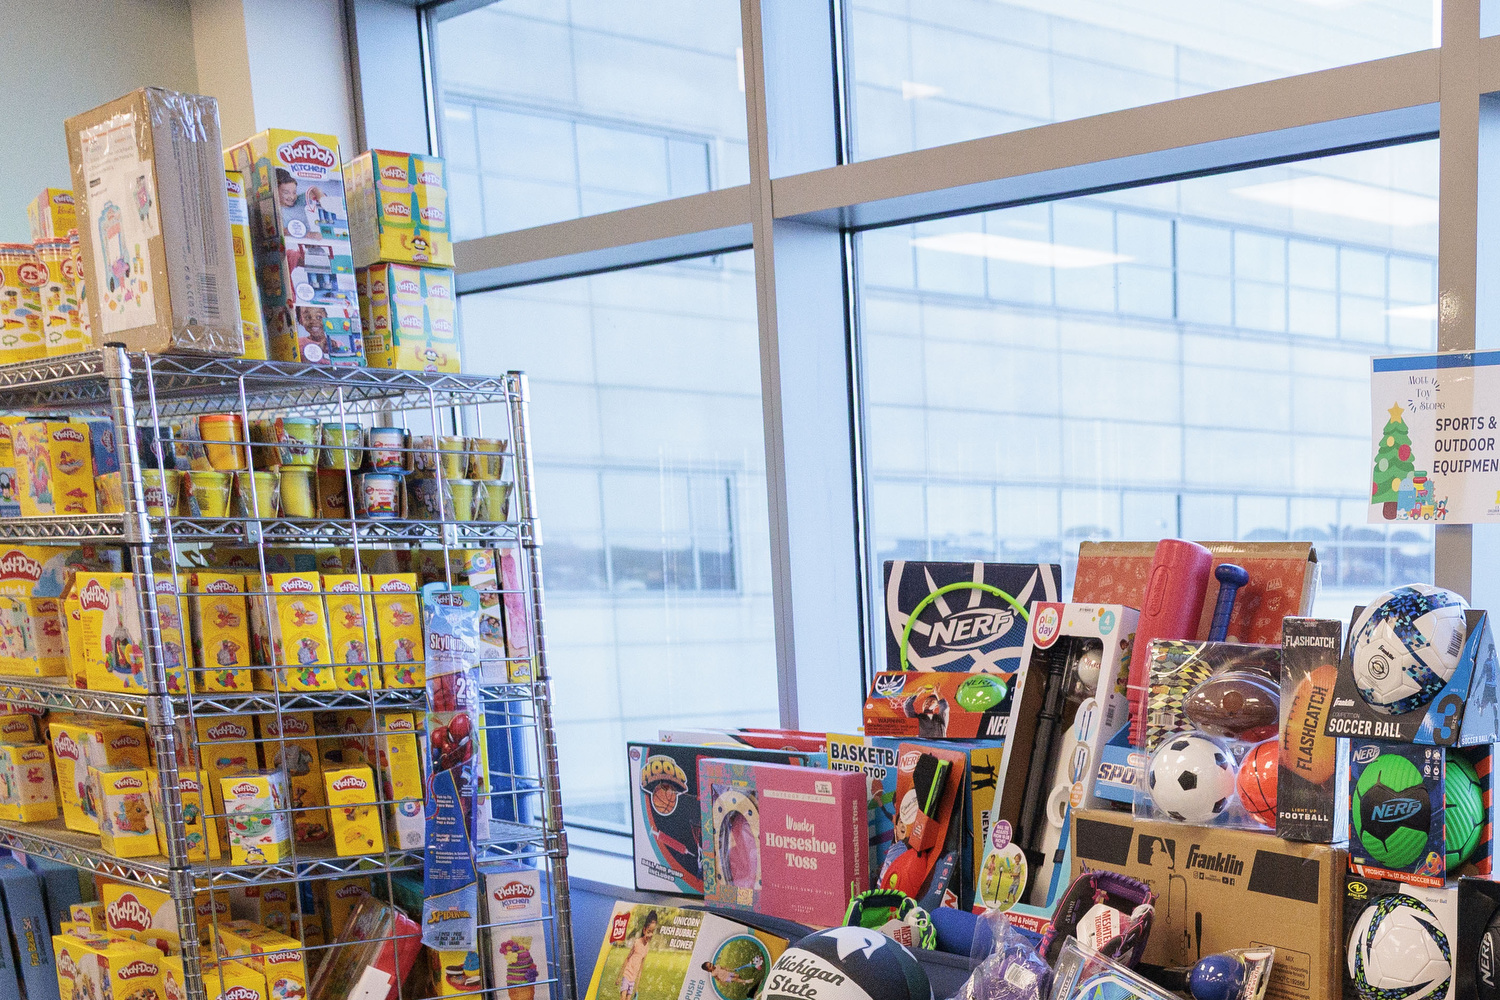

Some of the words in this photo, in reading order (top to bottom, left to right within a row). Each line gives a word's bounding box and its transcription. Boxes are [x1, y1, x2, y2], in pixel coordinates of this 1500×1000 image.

[1435, 416, 1485, 431] SPORTS
[1488, 416, 1498, 430] &
[1434, 438, 1495, 452] OUTDOOR
[928, 609, 1014, 648] NERF
[1285, 634, 1336, 650] FLASHCATCH
[1297, 685, 1329, 772] FLASHCATCH
[1329, 718, 1373, 736] SOCCER
[1375, 721, 1401, 739] BALL
[1353, 746, 1380, 762] NERF
[1279, 812, 1329, 822] FOOTBALL
[1371, 799, 1422, 822] NERF
[765, 833, 838, 855] Horseshoe
[1186, 844, 1244, 876] Franklin
[660, 925, 677, 937] PUSH
[678, 928, 698, 939] BUBBLE
[673, 916, 701, 927] UNICORN
[669, 938, 694, 950] BLOWER
[1480, 932, 1496, 987] NERF
[773, 955, 845, 987] Michigan
[769, 974, 818, 999] State
